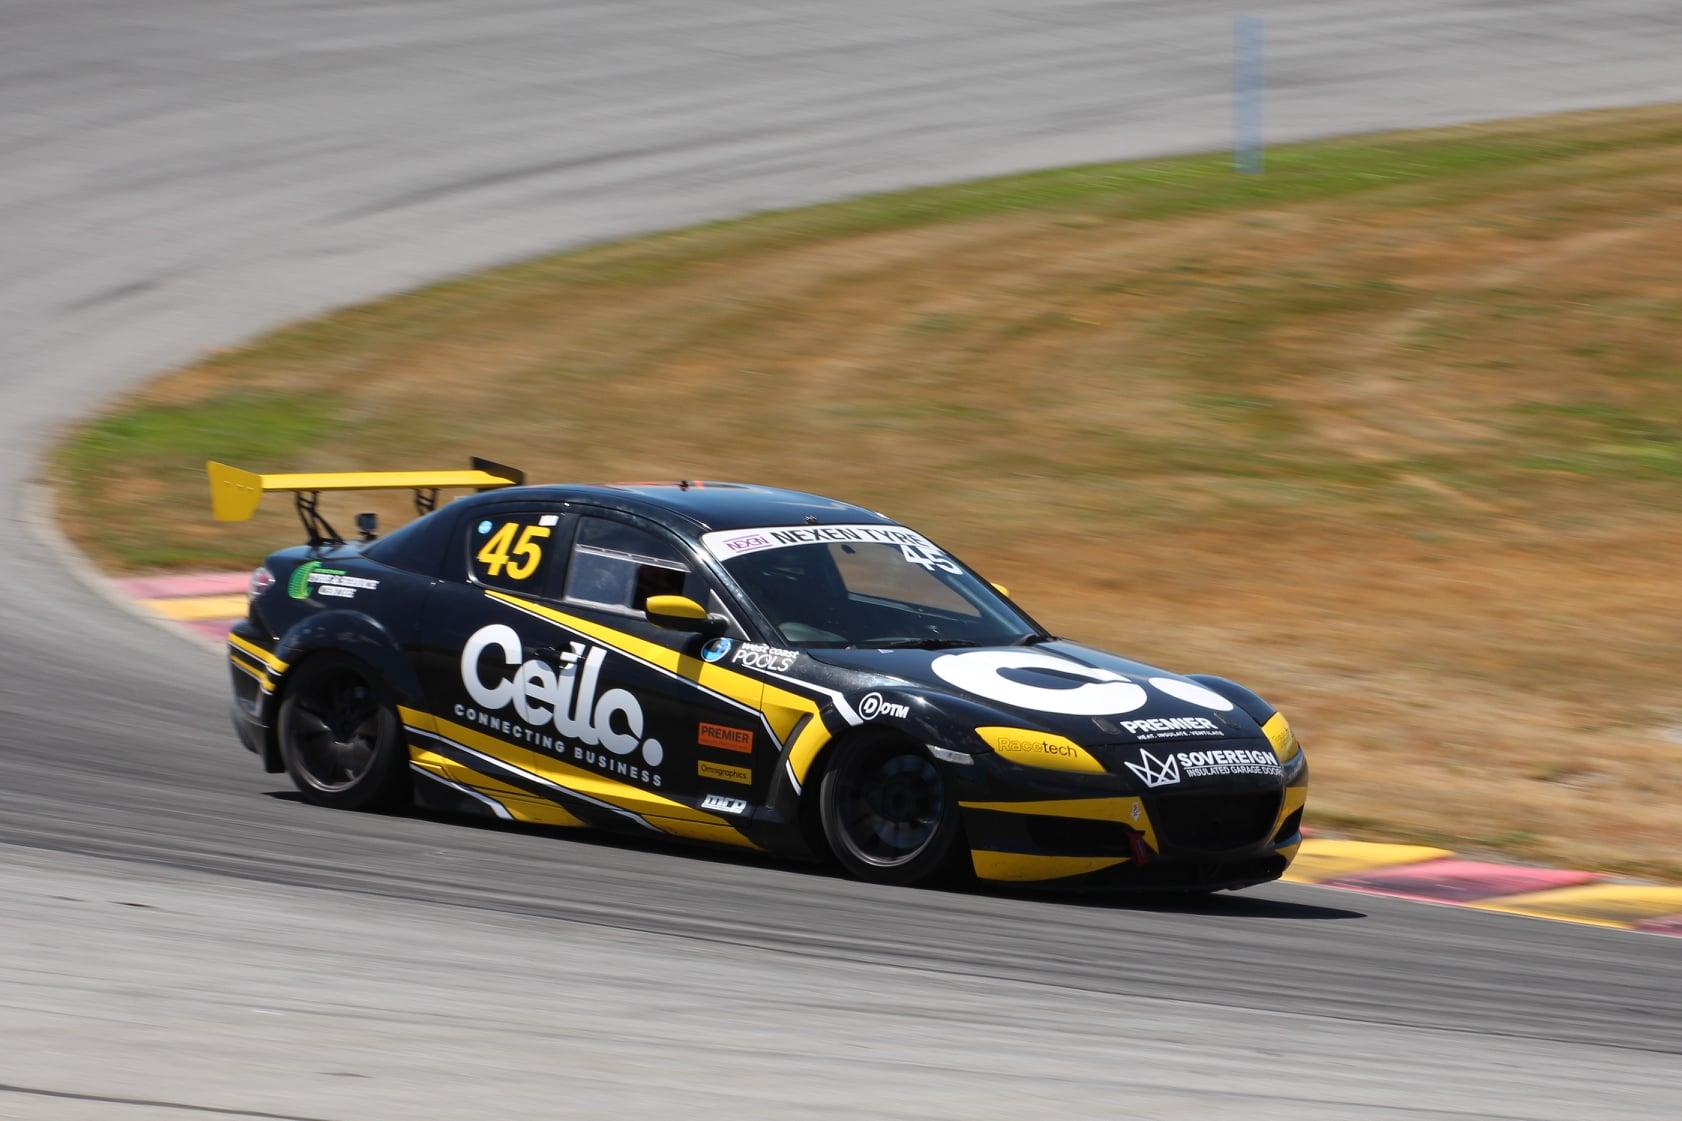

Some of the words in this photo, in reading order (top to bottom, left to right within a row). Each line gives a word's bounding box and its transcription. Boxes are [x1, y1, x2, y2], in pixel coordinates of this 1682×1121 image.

[770, 528, 861, 544] NEXEN
[477, 522, 551, 580] 45
[900, 544, 963, 575] 45
[731, 649, 793, 672] POOLS
[880, 703, 910, 719] DTM
[701, 725, 749, 744] PREMIER
[1120, 717, 1219, 734] PREMIER
[454, 703, 565, 753] CONNECTING
[574, 746, 662, 787] BUSINESS
[998, 737, 1077, 758] Racetech
[1177, 749, 1278, 767] SOVEREIGN
[1186, 766, 1230, 777] INSULATED
[1231, 766, 1262, 775] GARAGE
